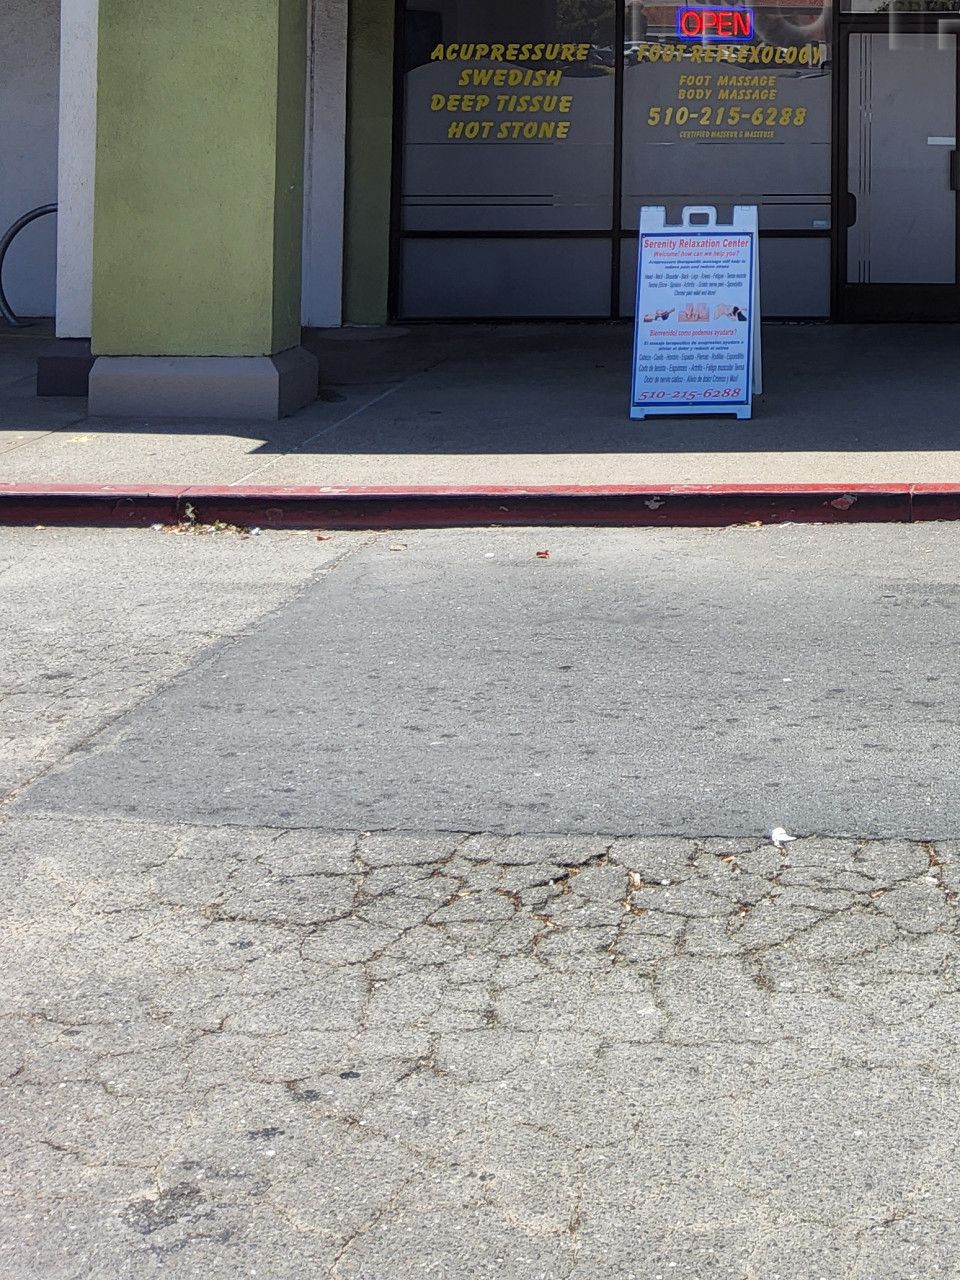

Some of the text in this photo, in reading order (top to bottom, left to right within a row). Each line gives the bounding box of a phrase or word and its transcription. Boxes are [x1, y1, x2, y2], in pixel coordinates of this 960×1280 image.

[681, 11, 751, 38] OPEN
[430, 43, 590, 62] ACUPRESSURE
[637, 44, 826, 65] FOOT REFLEXOLOGY
[458, 69, 563, 87] SWEDISH
[679, 74, 777, 87] FOOT MASSAGE
[430, 94, 573, 113] DEEP TISSUE
[678, 89, 778, 101] BODY MASSAGE
[647, 106, 807, 127] 510-215-6288
[447, 120, 571, 140] HOT STONE
[679, 130, 710, 139] CERTIFIED
[644, 239, 748, 250] Serenity Relaxation Center
[638, 387, 742, 401] 510-215-6288
